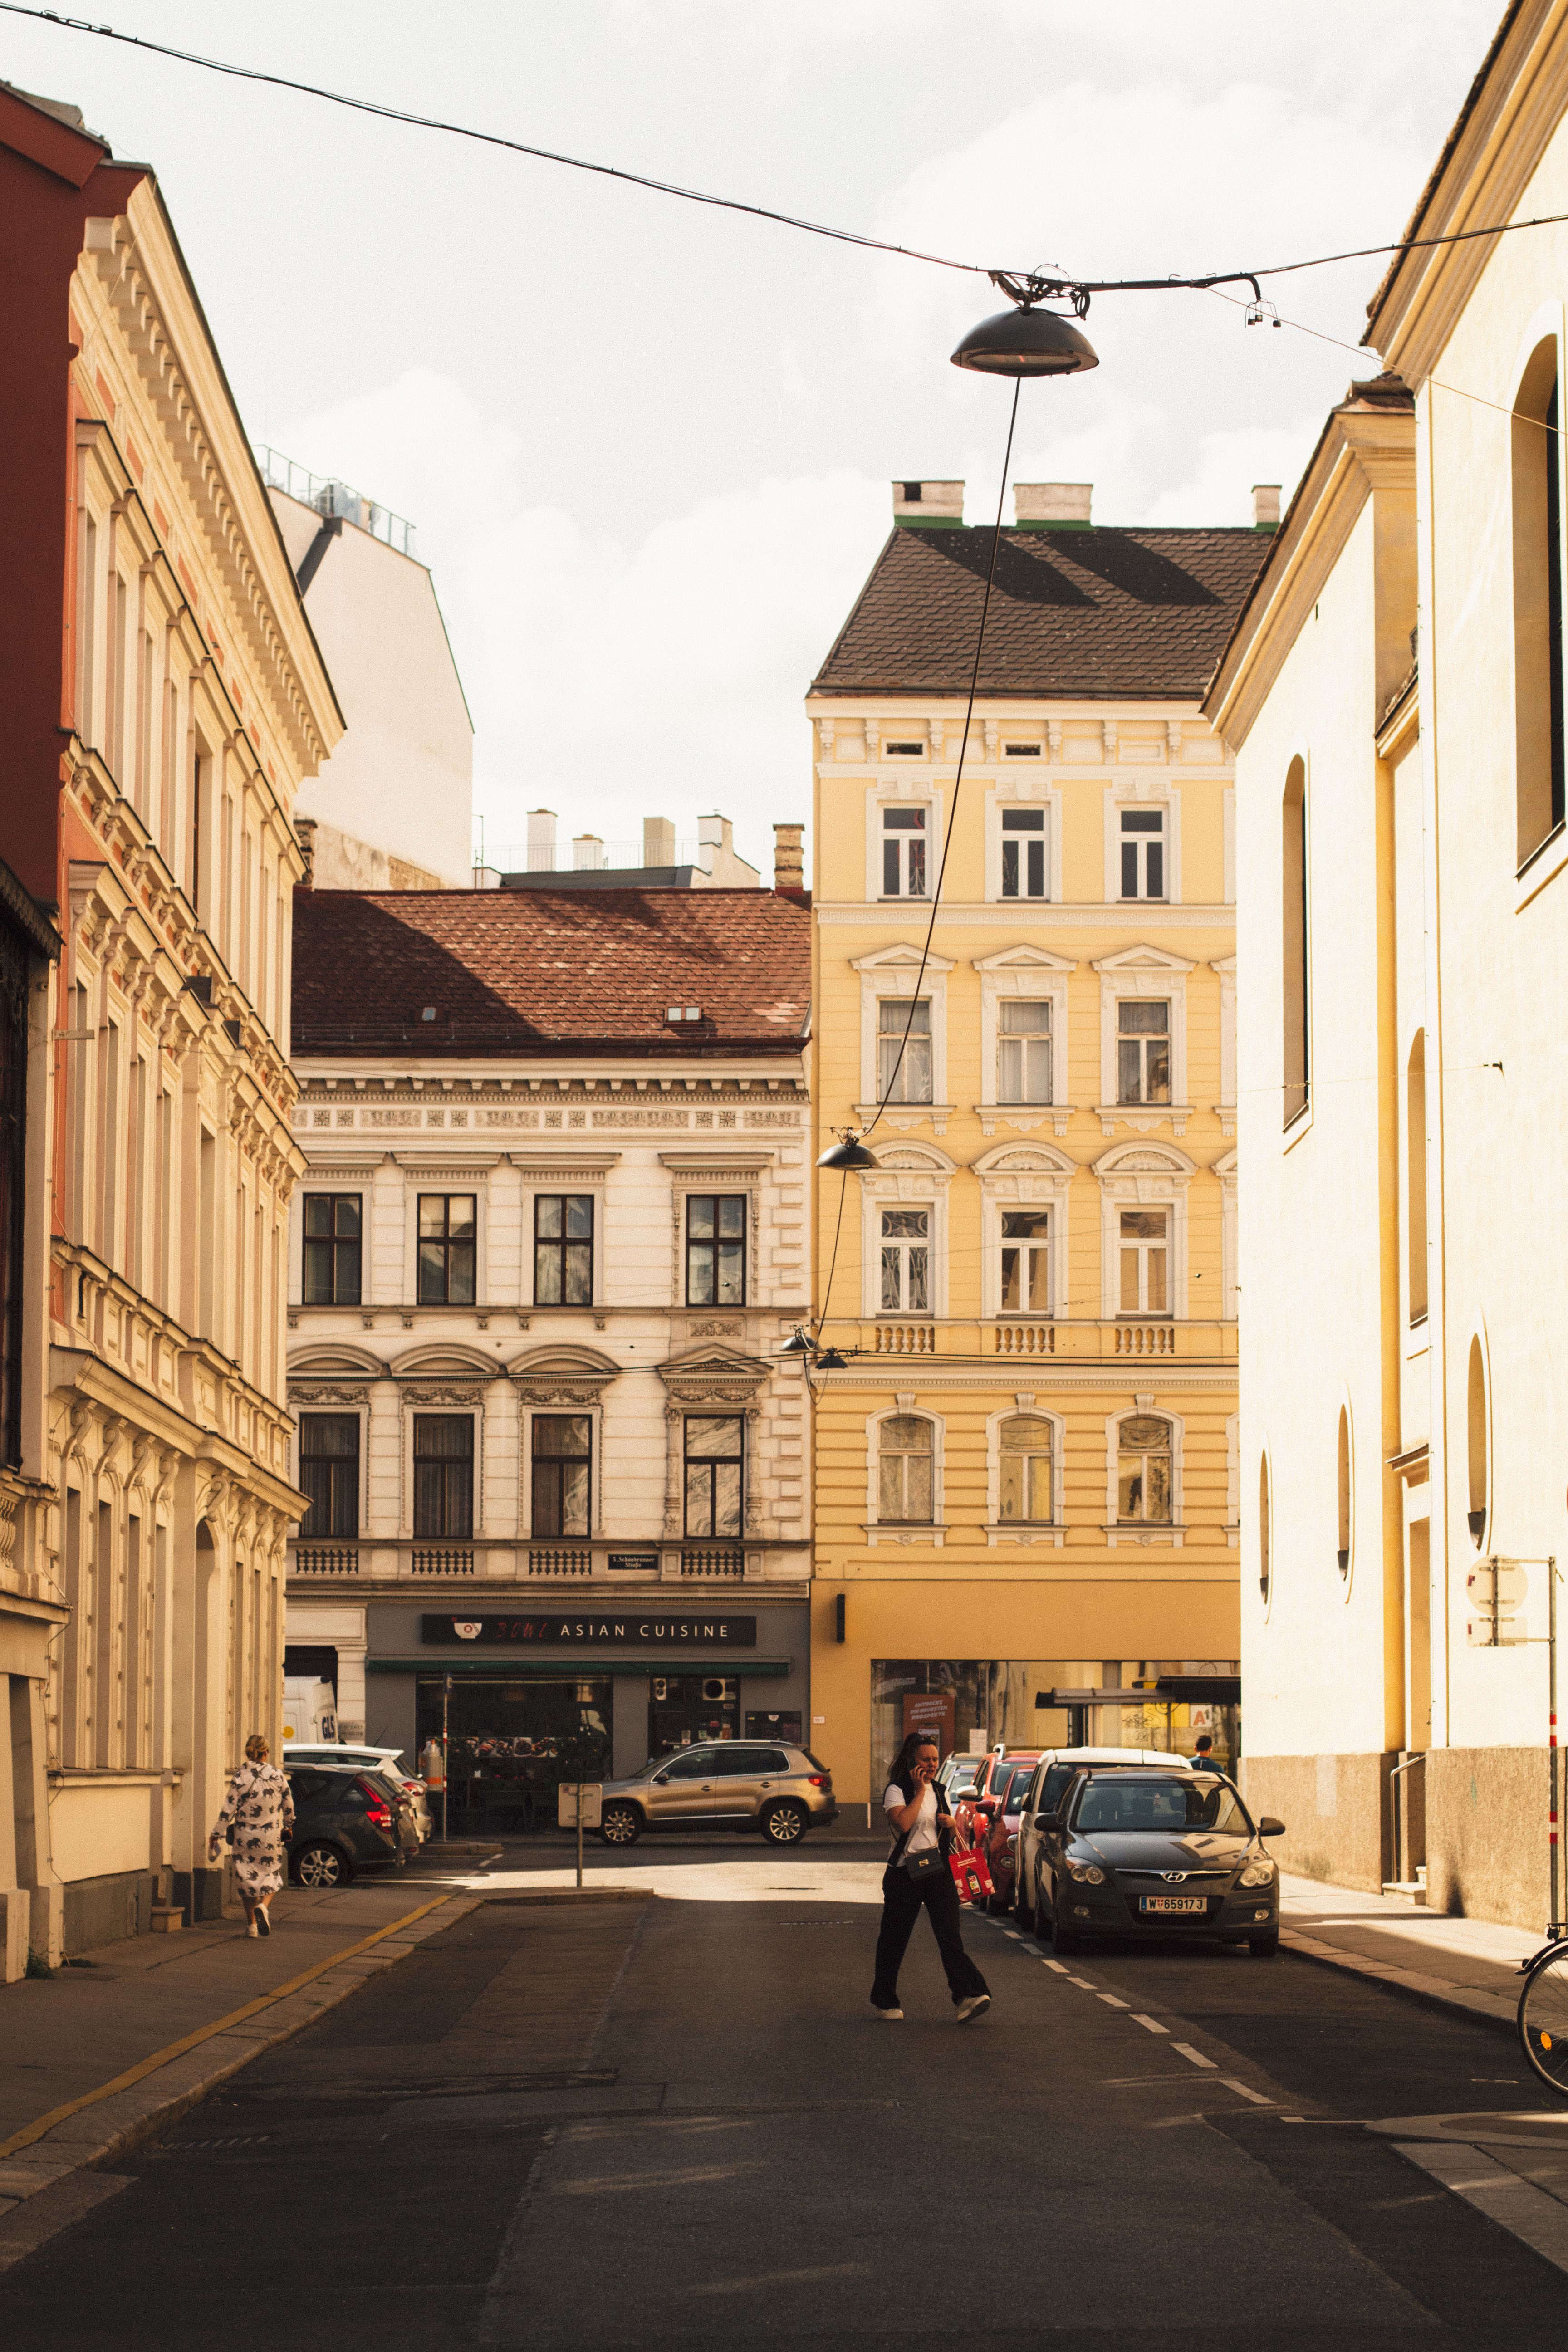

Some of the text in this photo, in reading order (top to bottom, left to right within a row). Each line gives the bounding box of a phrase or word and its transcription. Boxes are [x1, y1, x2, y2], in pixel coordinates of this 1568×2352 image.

[560, 1624, 625, 1636] ASIAN
[639, 1625, 728, 1637] CUISINE
[1193, 1709, 1210, 1726] A1
[322, 1715, 335, 1739] GLS
[1149, 1899, 1156, 1909] W
